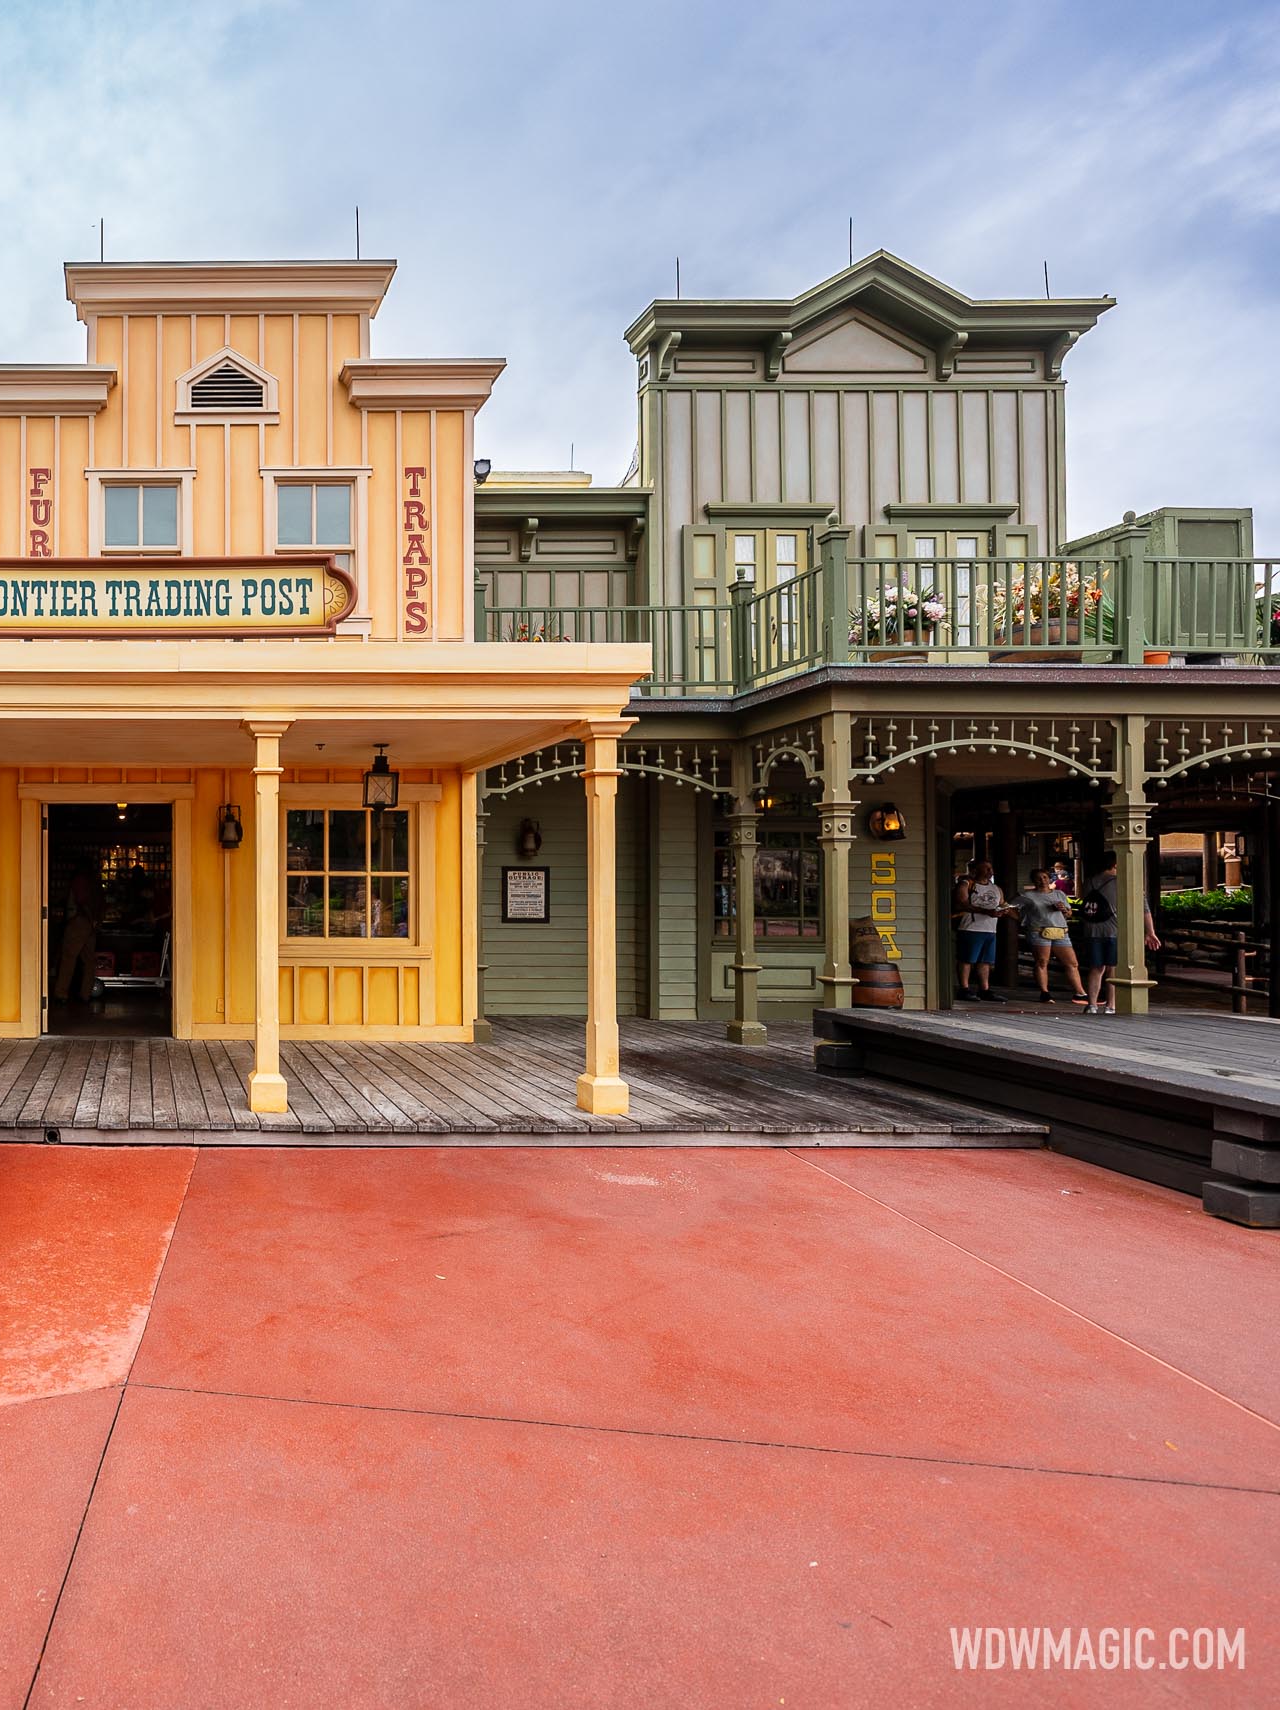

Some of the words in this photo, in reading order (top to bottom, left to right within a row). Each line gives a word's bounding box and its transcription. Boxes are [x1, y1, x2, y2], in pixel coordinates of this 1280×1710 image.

[105, 578, 233, 617] TRADING
[241, 577, 314, 616] POST
[403, 466, 430, 634] TRAPS
